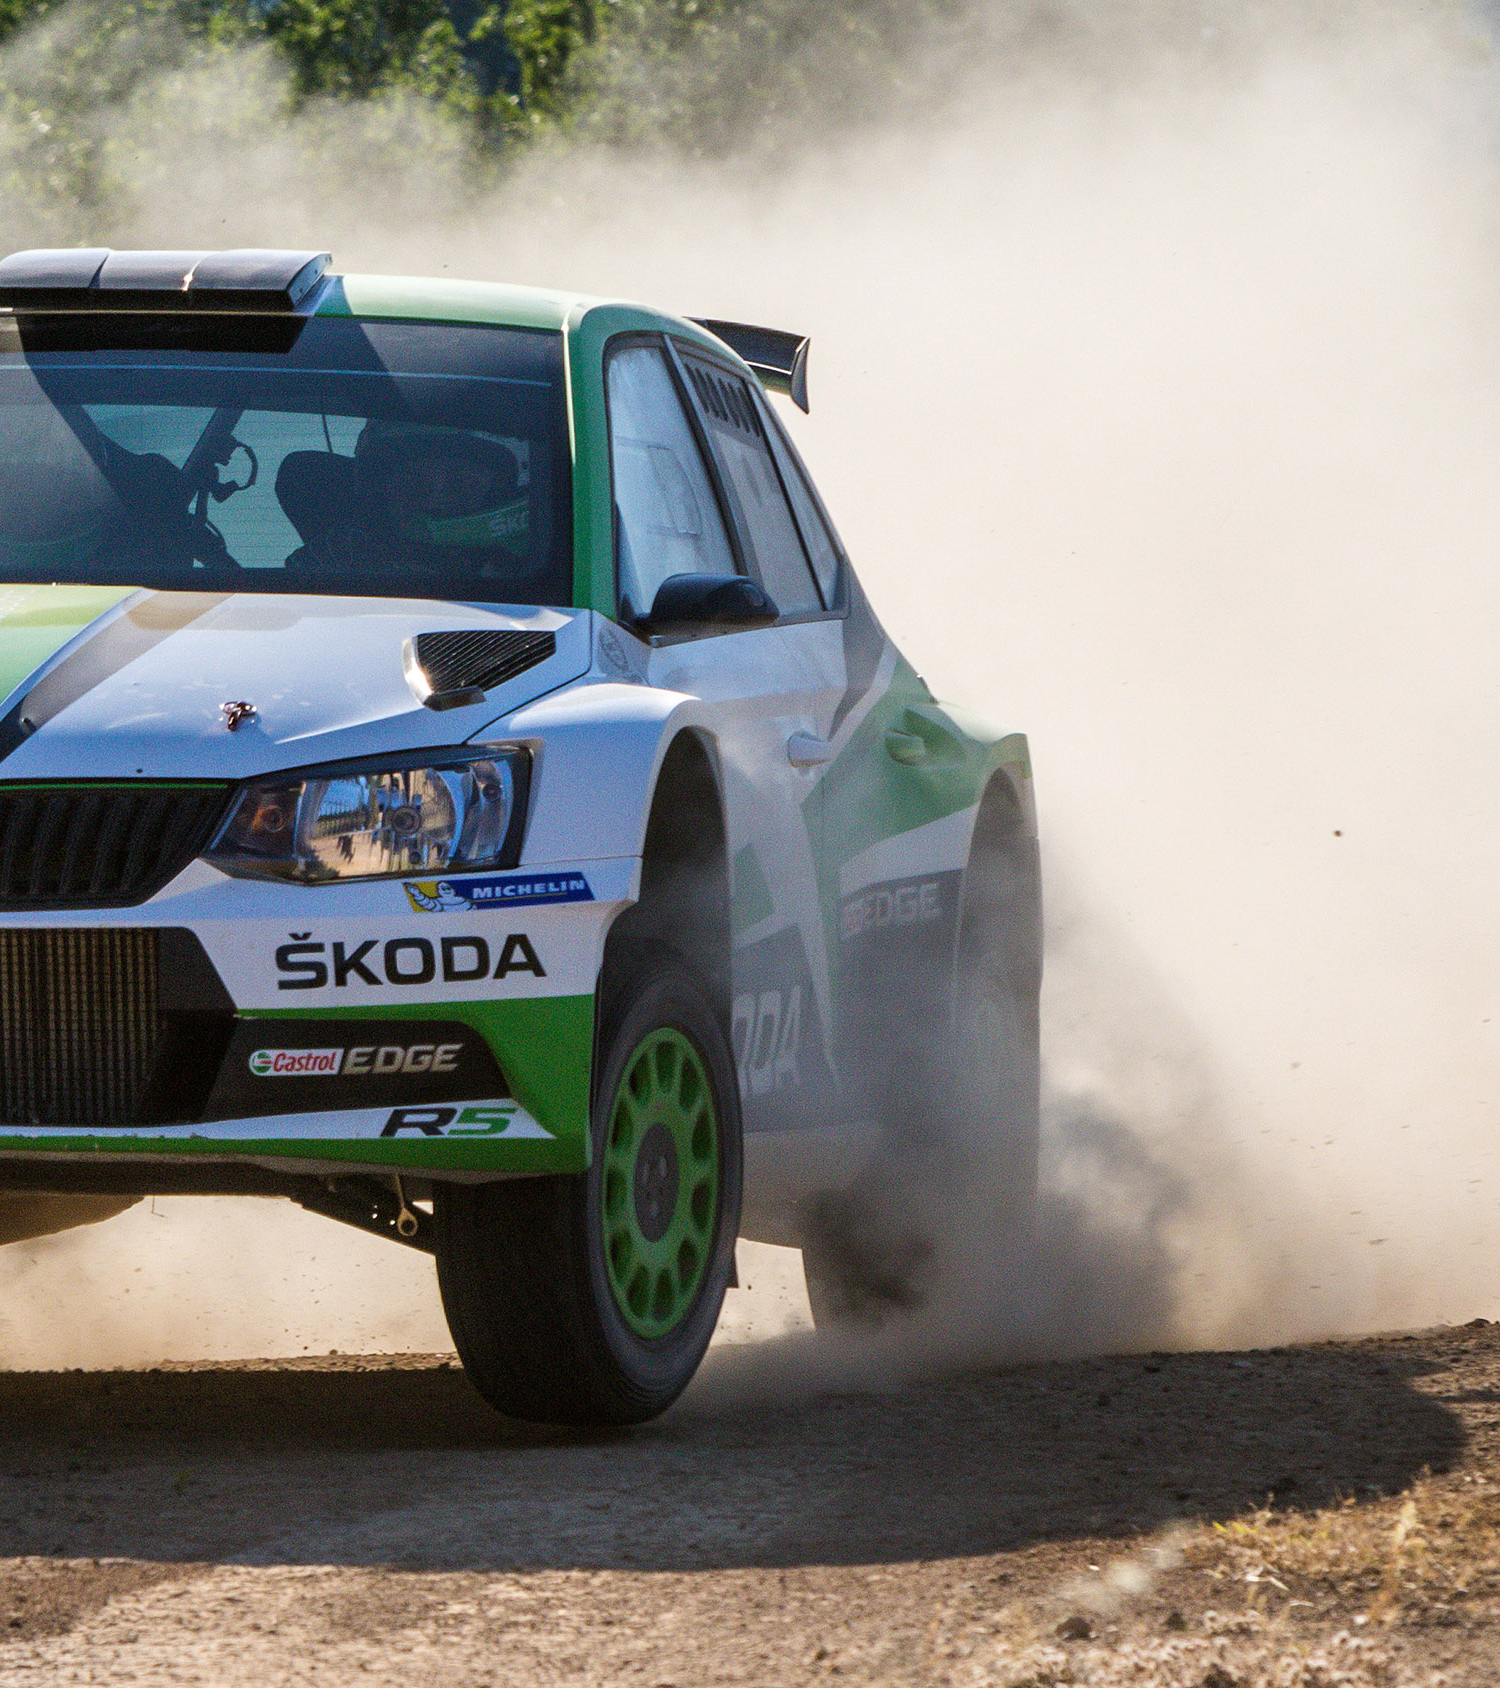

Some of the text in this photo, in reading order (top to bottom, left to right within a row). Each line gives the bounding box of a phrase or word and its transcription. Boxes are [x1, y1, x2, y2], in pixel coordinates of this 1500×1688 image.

[472, 878, 586, 900] MICHELIN
[274, 931, 548, 991] ŠKODA
[273, 1043, 464, 1075] Castrol EDGE
[379, 1106, 519, 1138] R5
